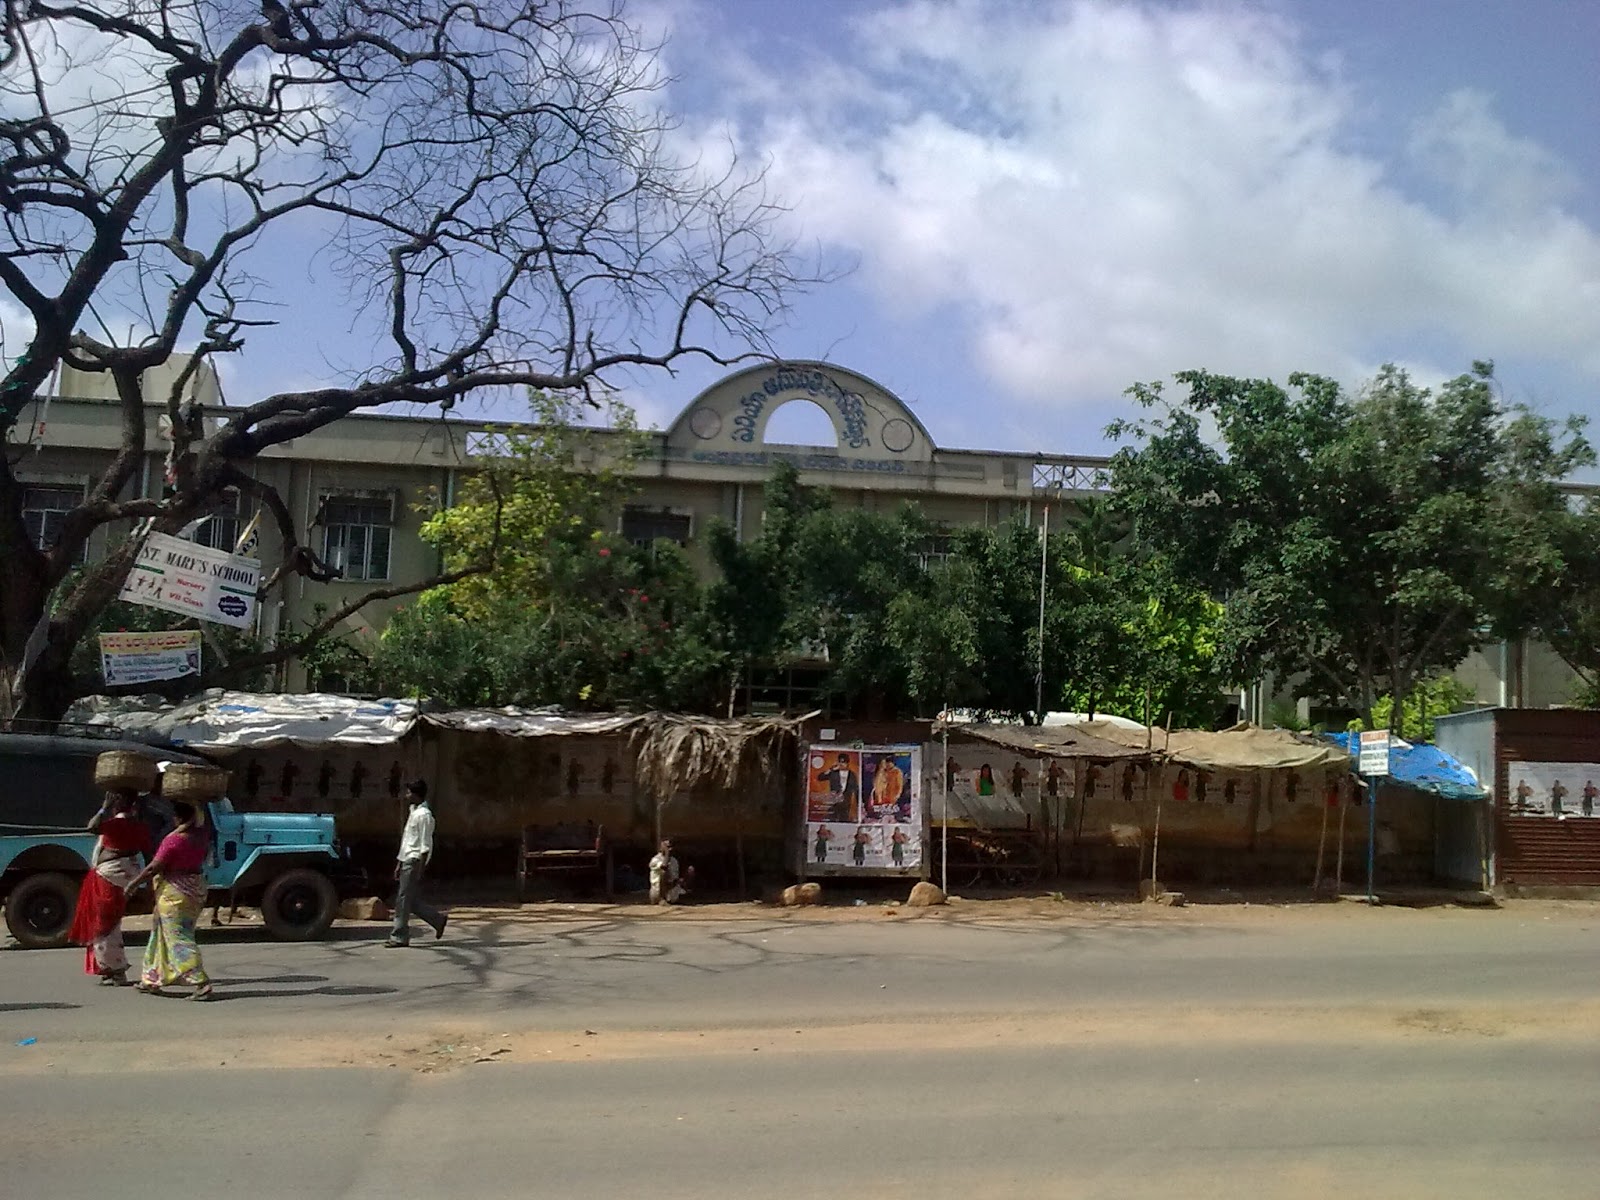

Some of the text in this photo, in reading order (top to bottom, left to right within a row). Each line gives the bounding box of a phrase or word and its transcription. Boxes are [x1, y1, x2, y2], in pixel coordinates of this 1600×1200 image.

[140, 546, 256, 587] ST. MARY'S SCHOOL
[176, 577, 206, 591] Nursery
